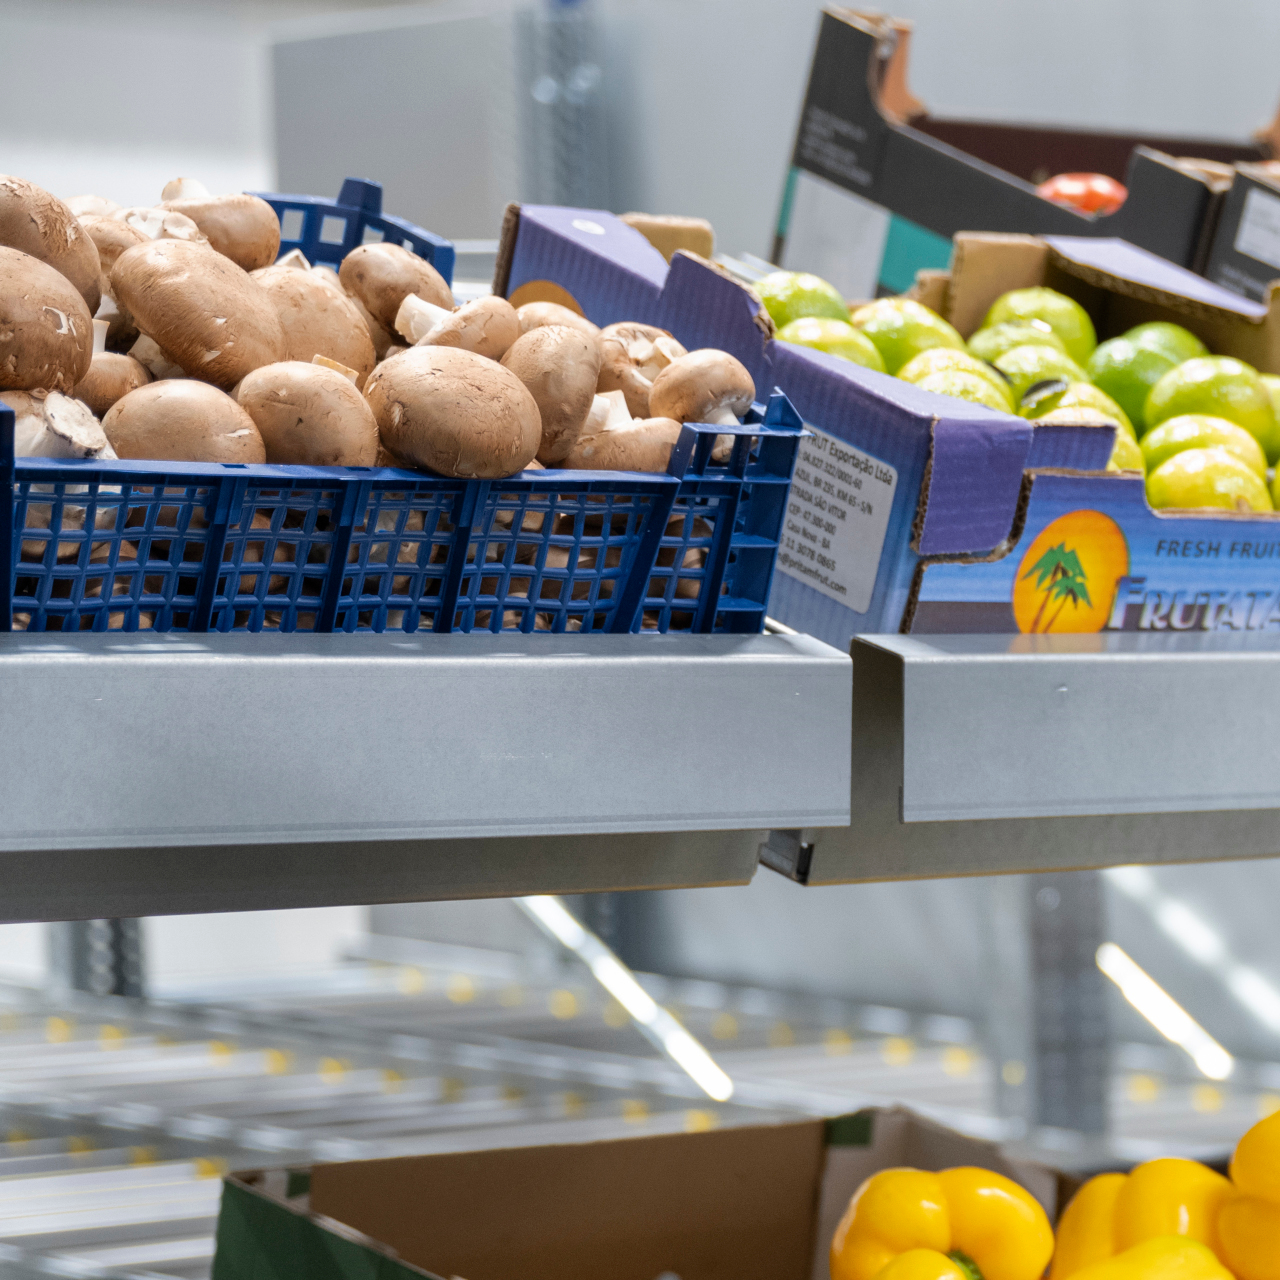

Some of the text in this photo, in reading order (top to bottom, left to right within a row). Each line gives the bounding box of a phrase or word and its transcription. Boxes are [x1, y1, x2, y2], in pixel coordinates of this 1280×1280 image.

[830, 443, 874, 476] Exportação
[875, 465, 892, 486] Ltda
[1155, 539, 1221, 558] FRESH
